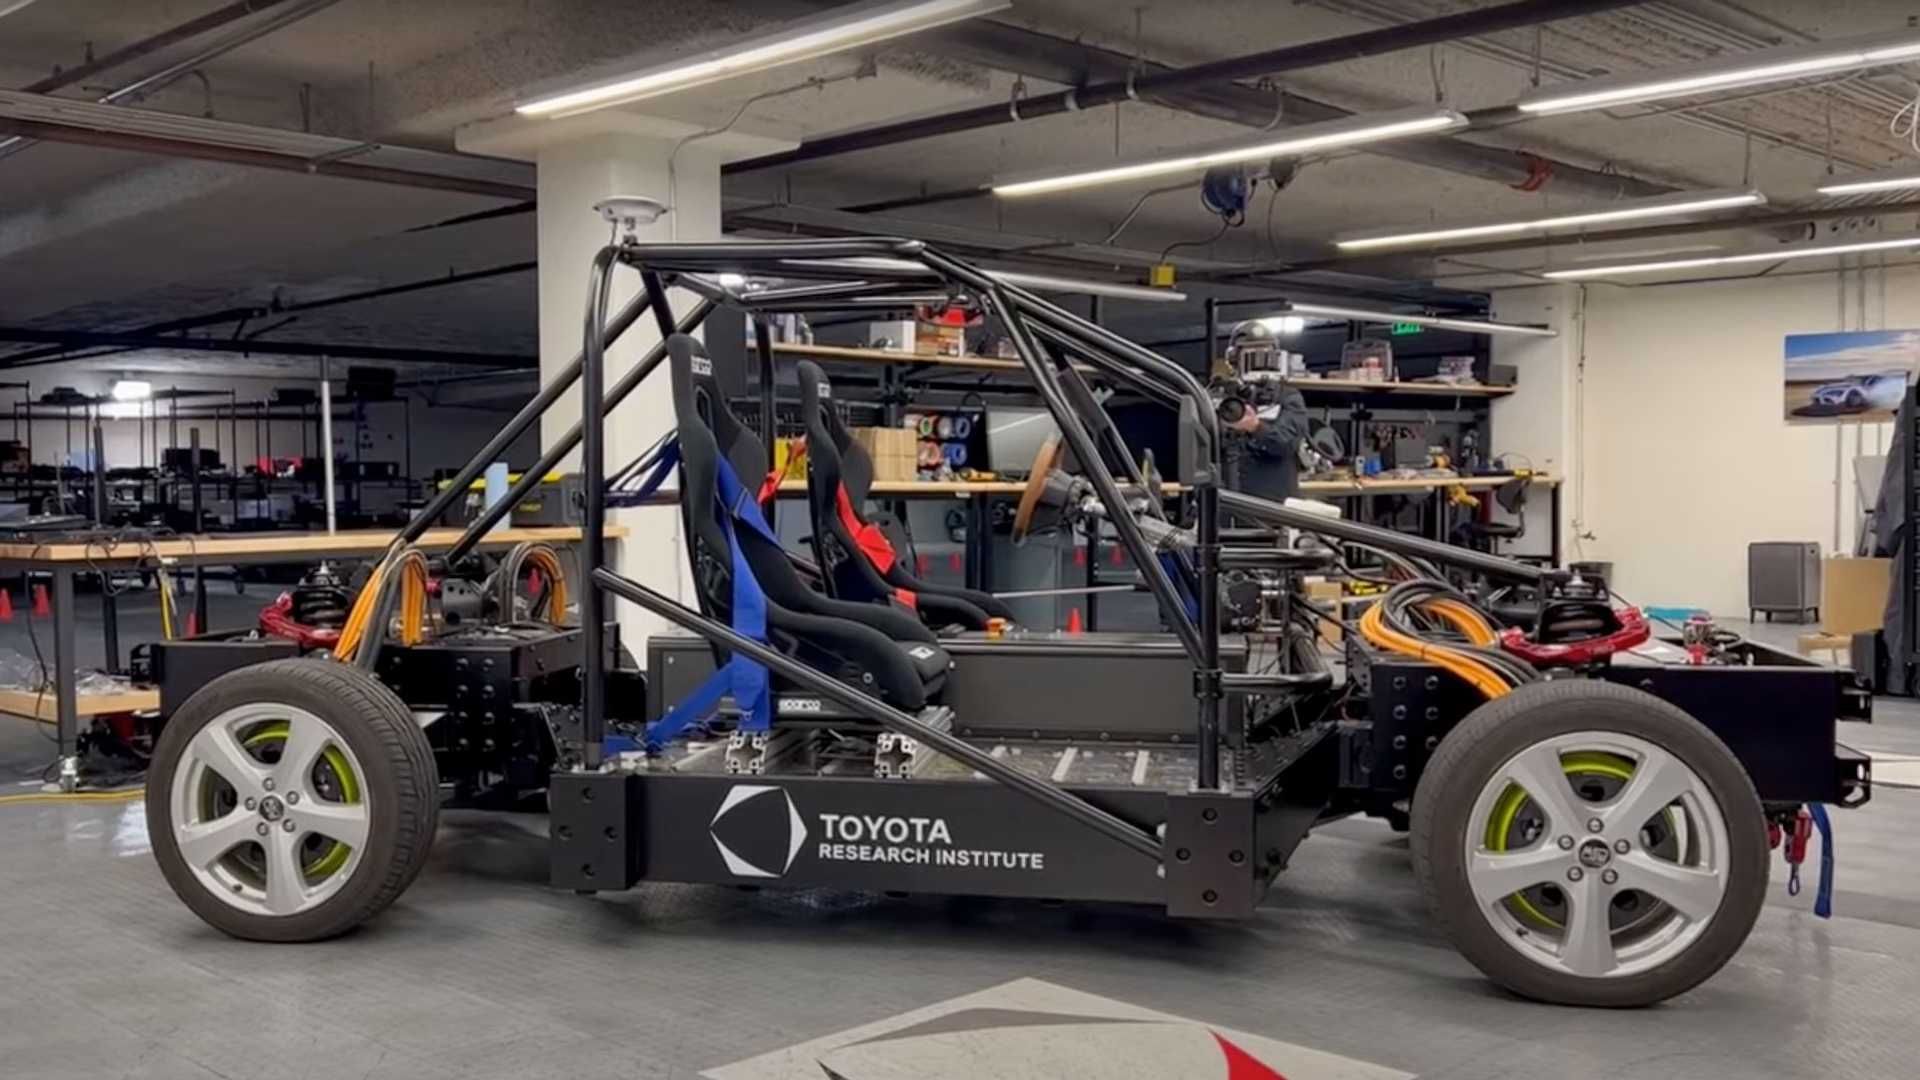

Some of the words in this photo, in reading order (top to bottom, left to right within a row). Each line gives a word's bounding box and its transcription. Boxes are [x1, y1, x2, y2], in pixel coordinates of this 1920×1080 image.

[819, 813, 952, 845] TOYOTA
[819, 843, 929, 864] RESEARCH
[936, 850, 1044, 869] INSTITUTE
